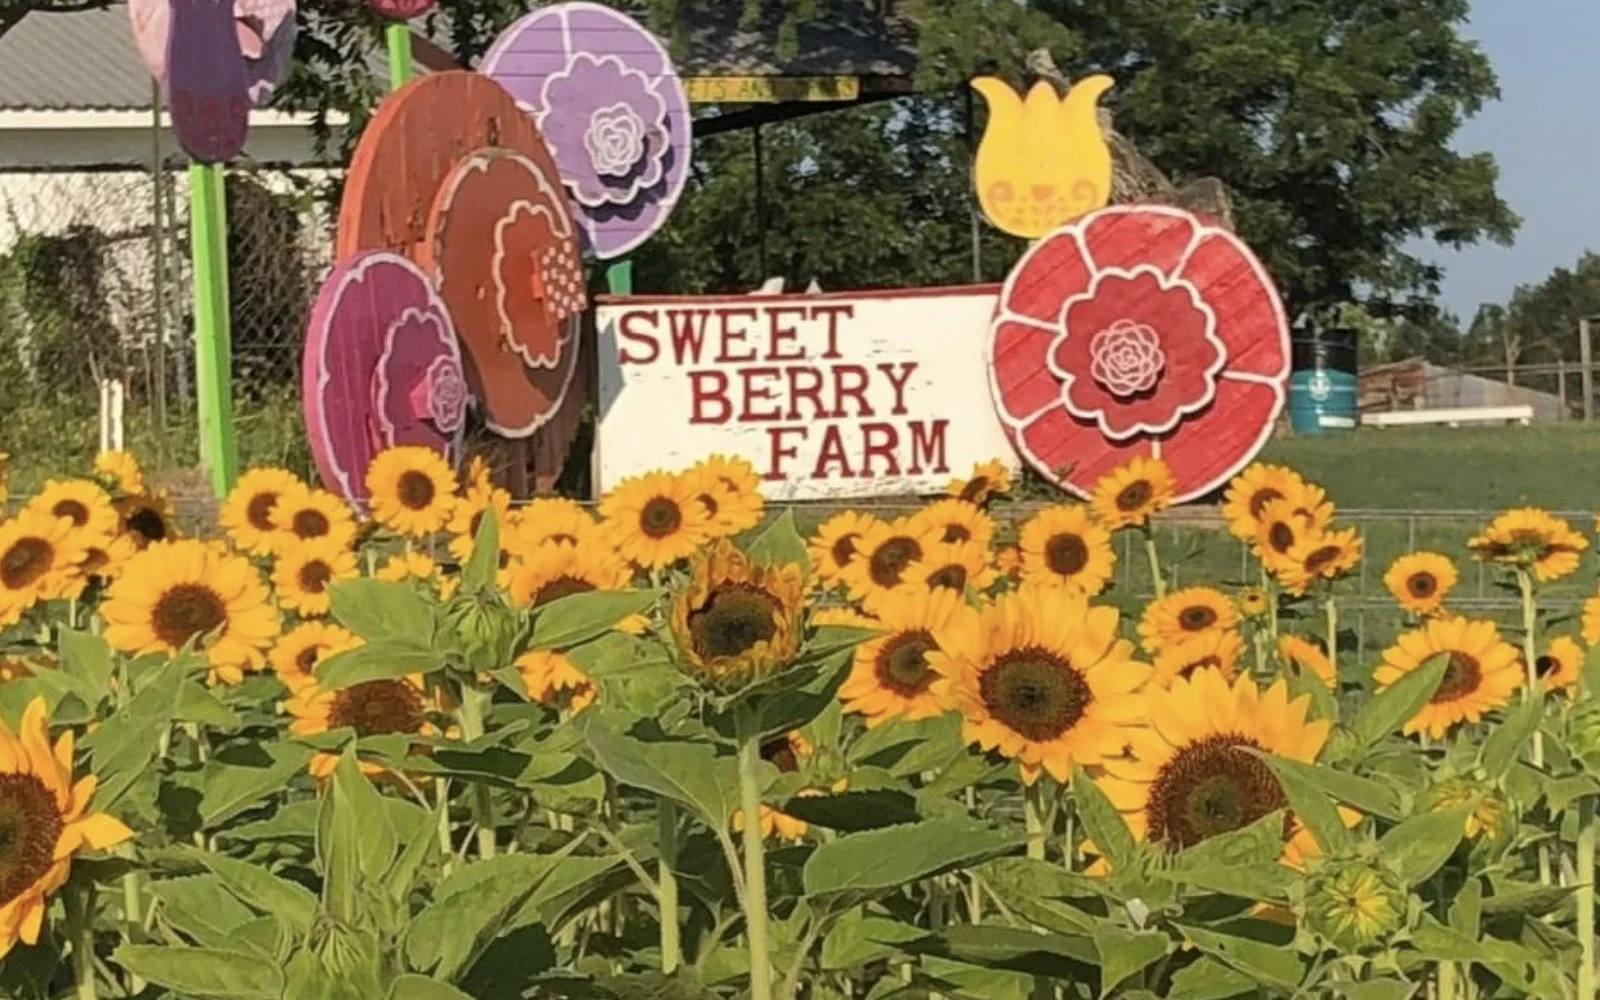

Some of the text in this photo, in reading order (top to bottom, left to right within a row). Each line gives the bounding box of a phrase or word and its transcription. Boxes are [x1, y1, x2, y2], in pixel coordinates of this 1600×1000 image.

[618, 305, 853, 364] SWEET
[688, 362, 918, 424] BERRY
[765, 420, 950, 481] FARM
